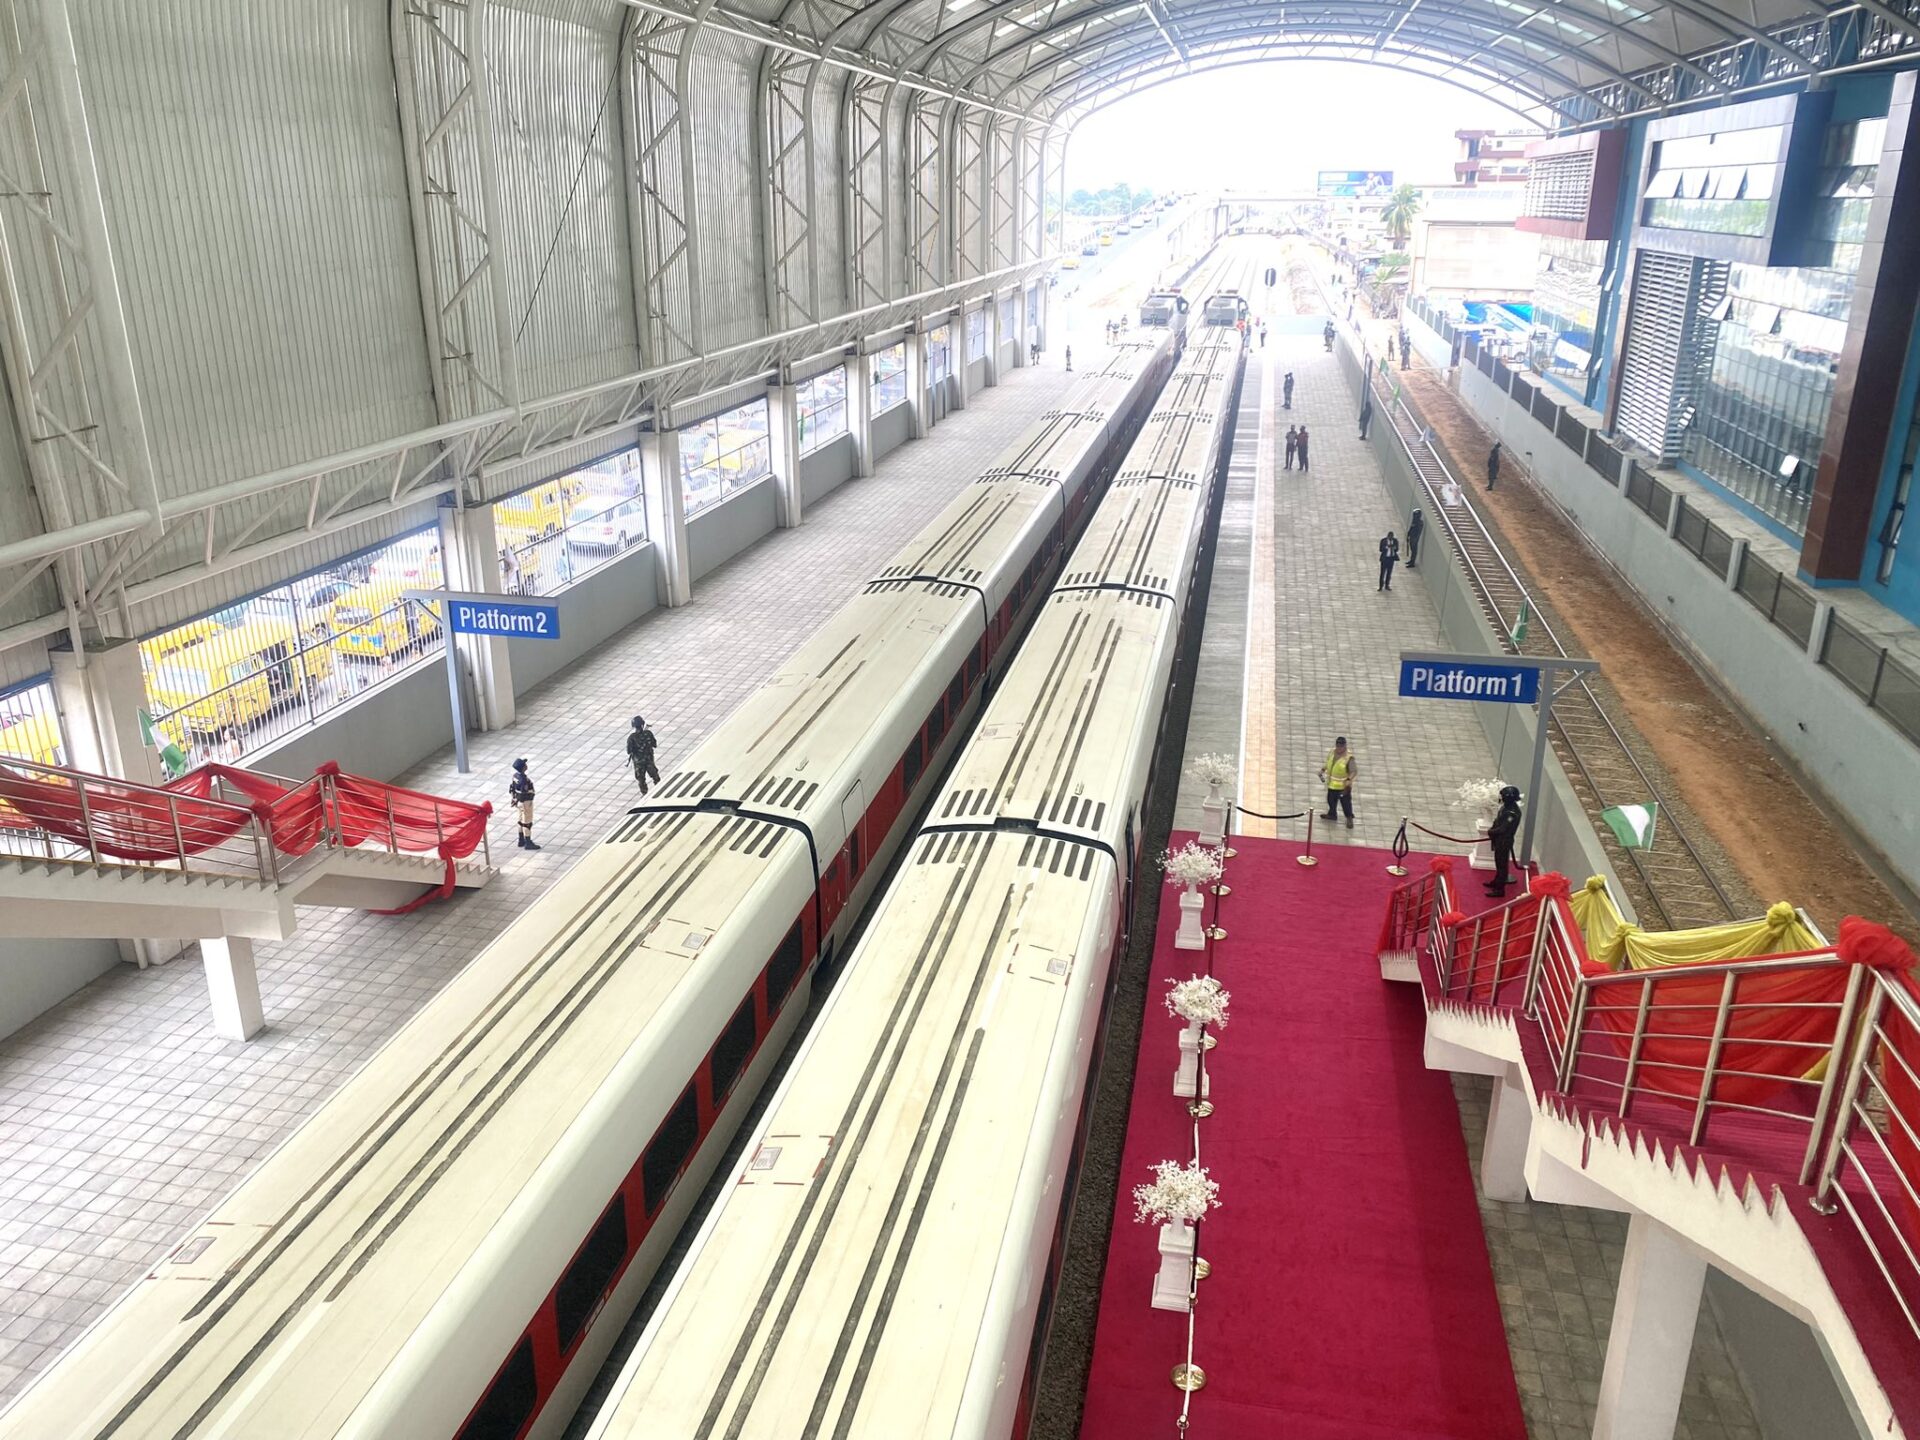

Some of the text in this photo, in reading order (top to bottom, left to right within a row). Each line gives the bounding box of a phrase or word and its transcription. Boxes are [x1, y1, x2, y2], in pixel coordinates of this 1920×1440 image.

[460, 606, 548, 633] Platform 2
[1411, 667, 1522, 697] Platform 1
